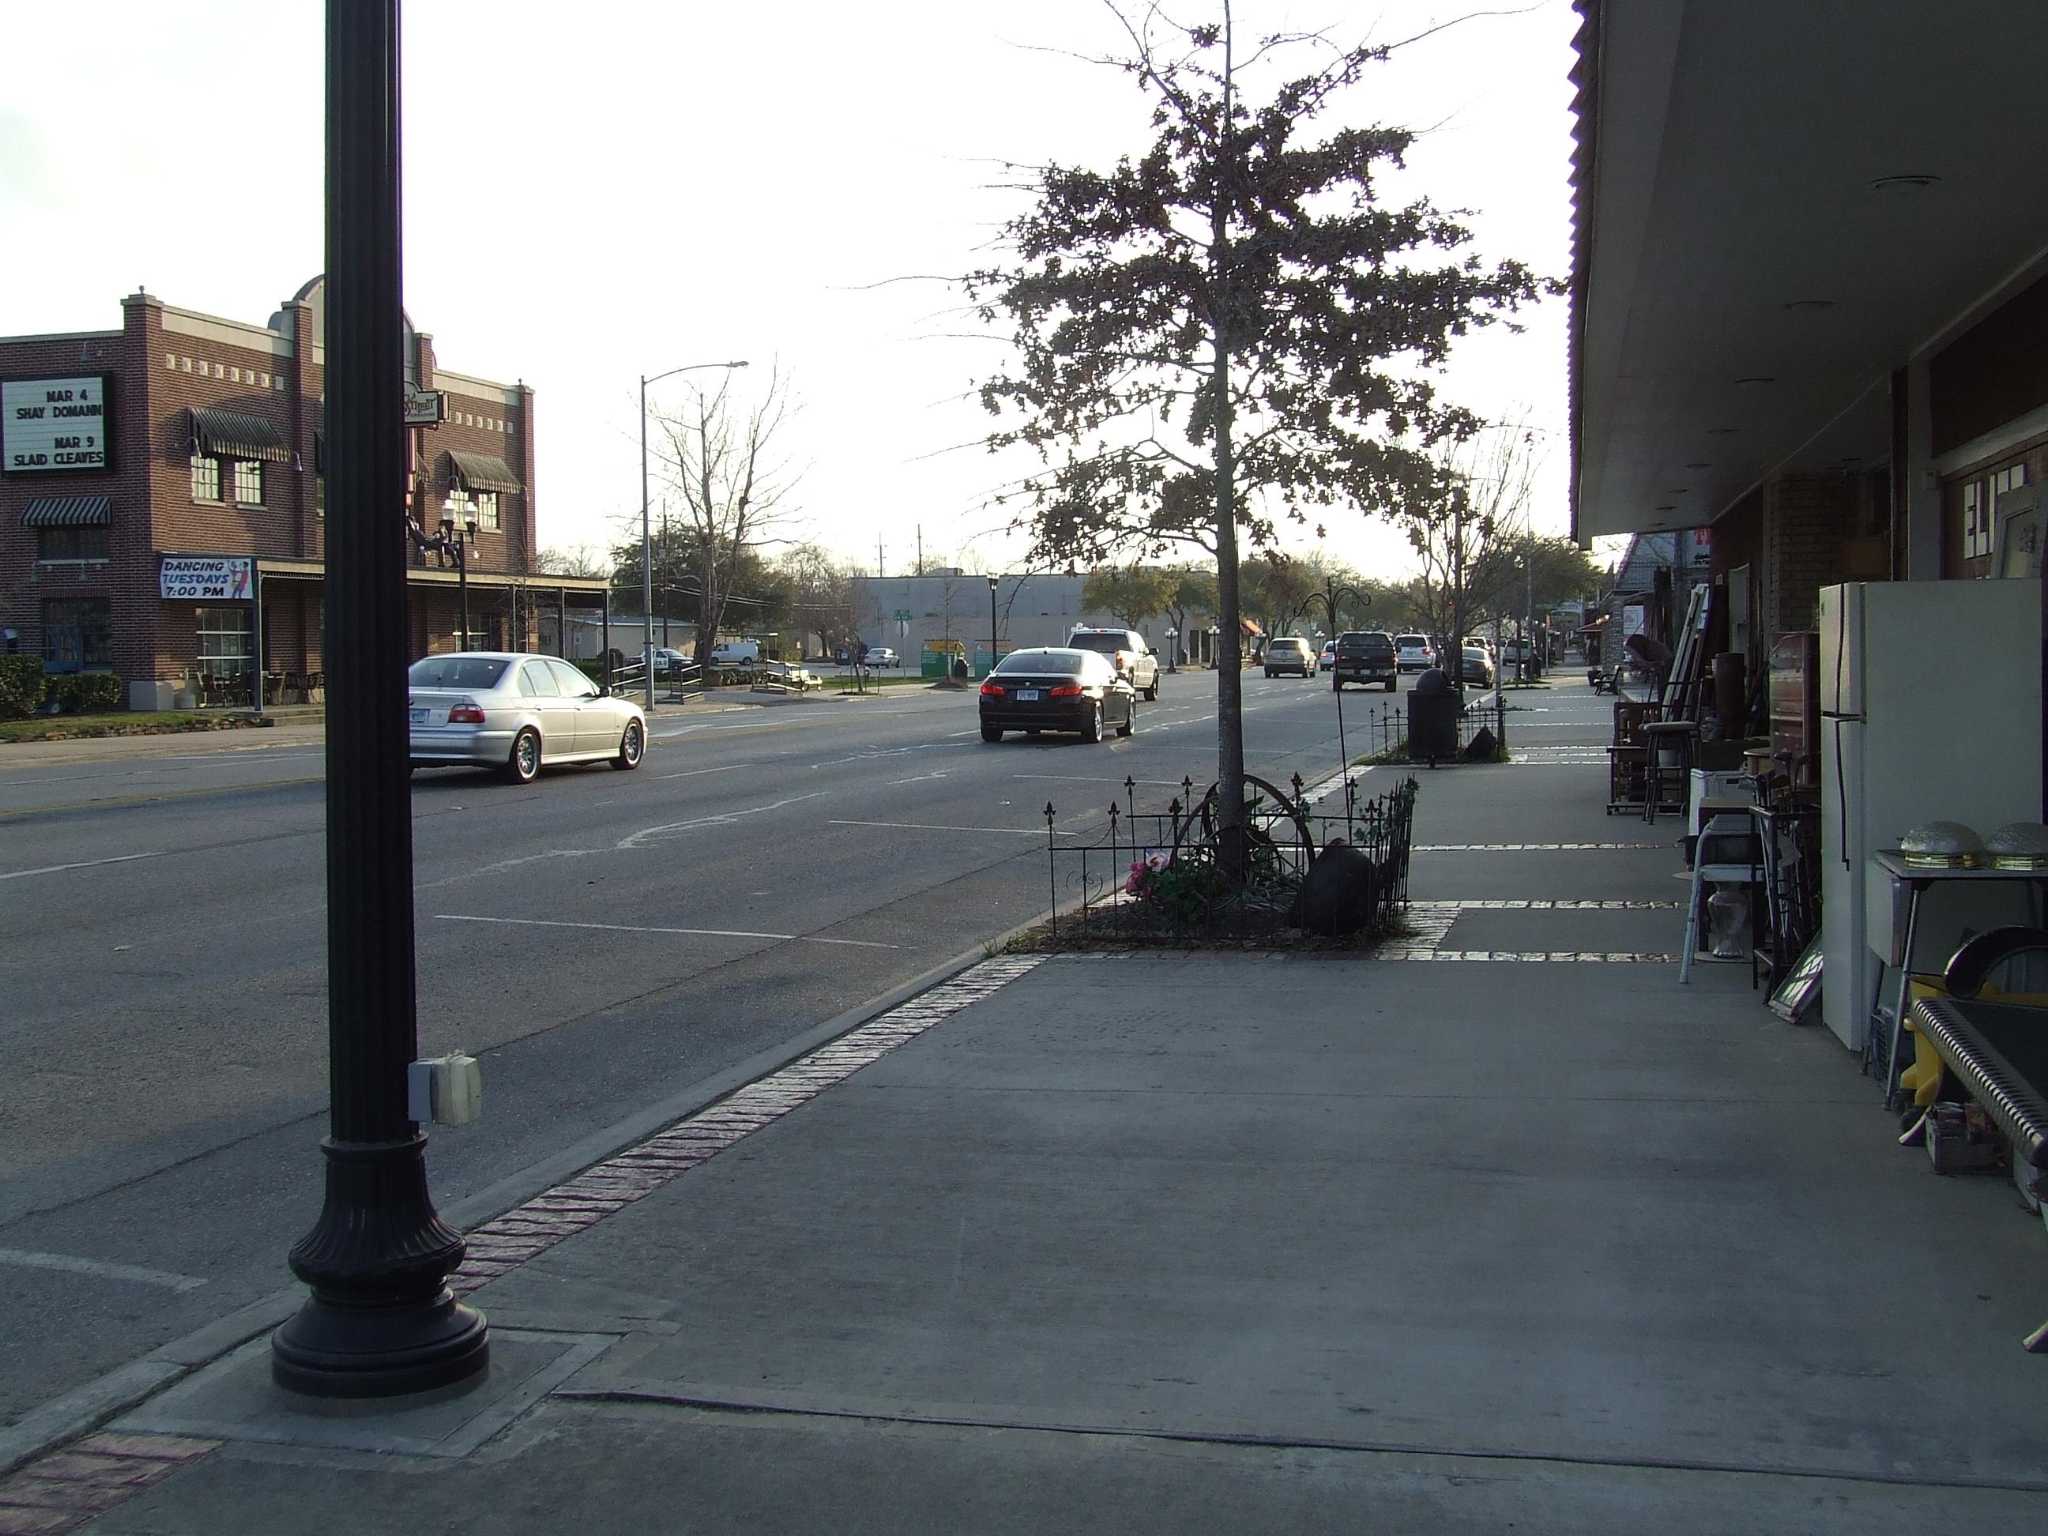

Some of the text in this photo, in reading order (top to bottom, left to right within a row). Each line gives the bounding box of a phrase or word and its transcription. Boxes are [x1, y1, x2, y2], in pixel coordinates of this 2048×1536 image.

[46, 388, 88, 402] MAR 4
[16, 407, 45, 419] SHAY
[54, 436, 95, 449] MAR 9
[14, 451, 104, 466] SLAID CLEAVES
[164, 561, 224, 571] DANCING
[163, 574, 229, 584] TUESDAYS
[166, 586, 224, 597] 7:00 PM
